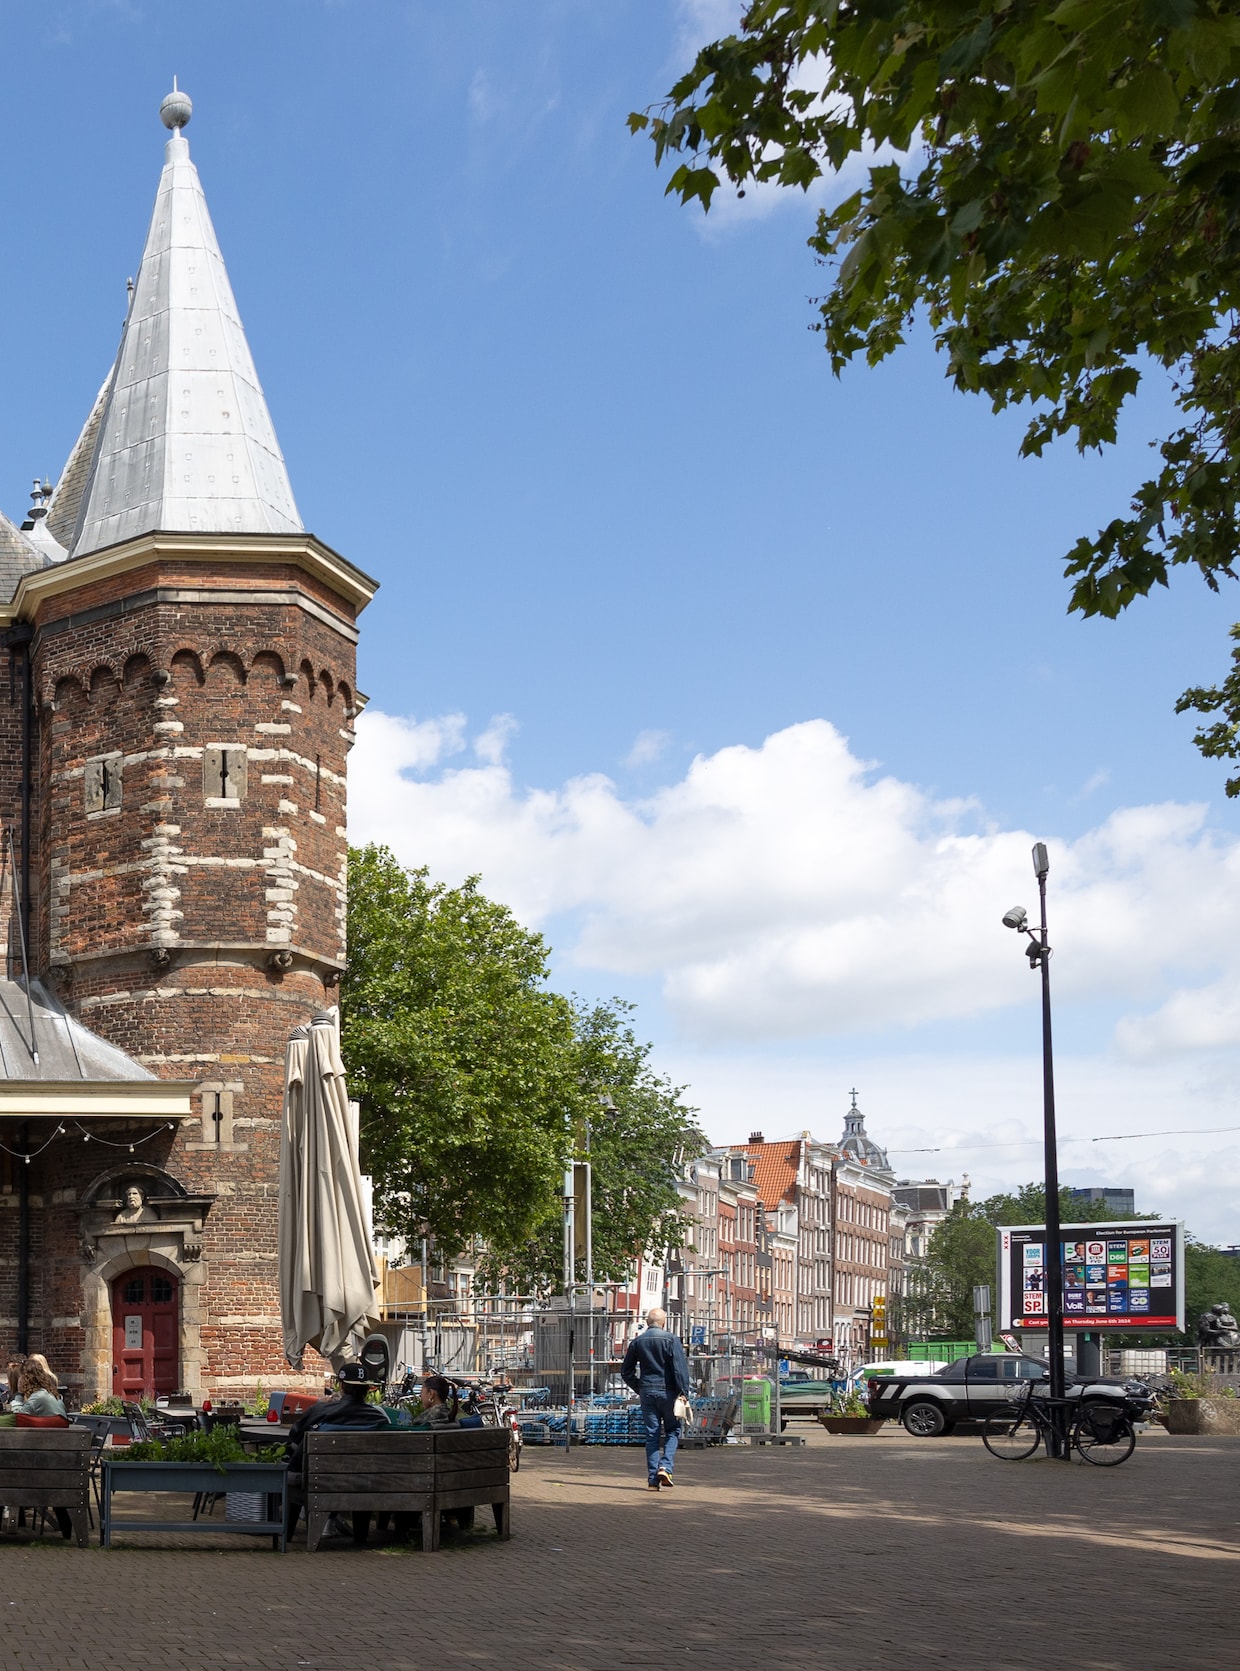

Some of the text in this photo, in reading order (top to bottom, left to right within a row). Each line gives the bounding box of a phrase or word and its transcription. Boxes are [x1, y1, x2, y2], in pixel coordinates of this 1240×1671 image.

[1153, 1246, 1167, 1254] 50
[1066, 1302, 1084, 1310] Volt
[693, 1327, 703, 1337] P
[357, 1367, 365, 1379] B
